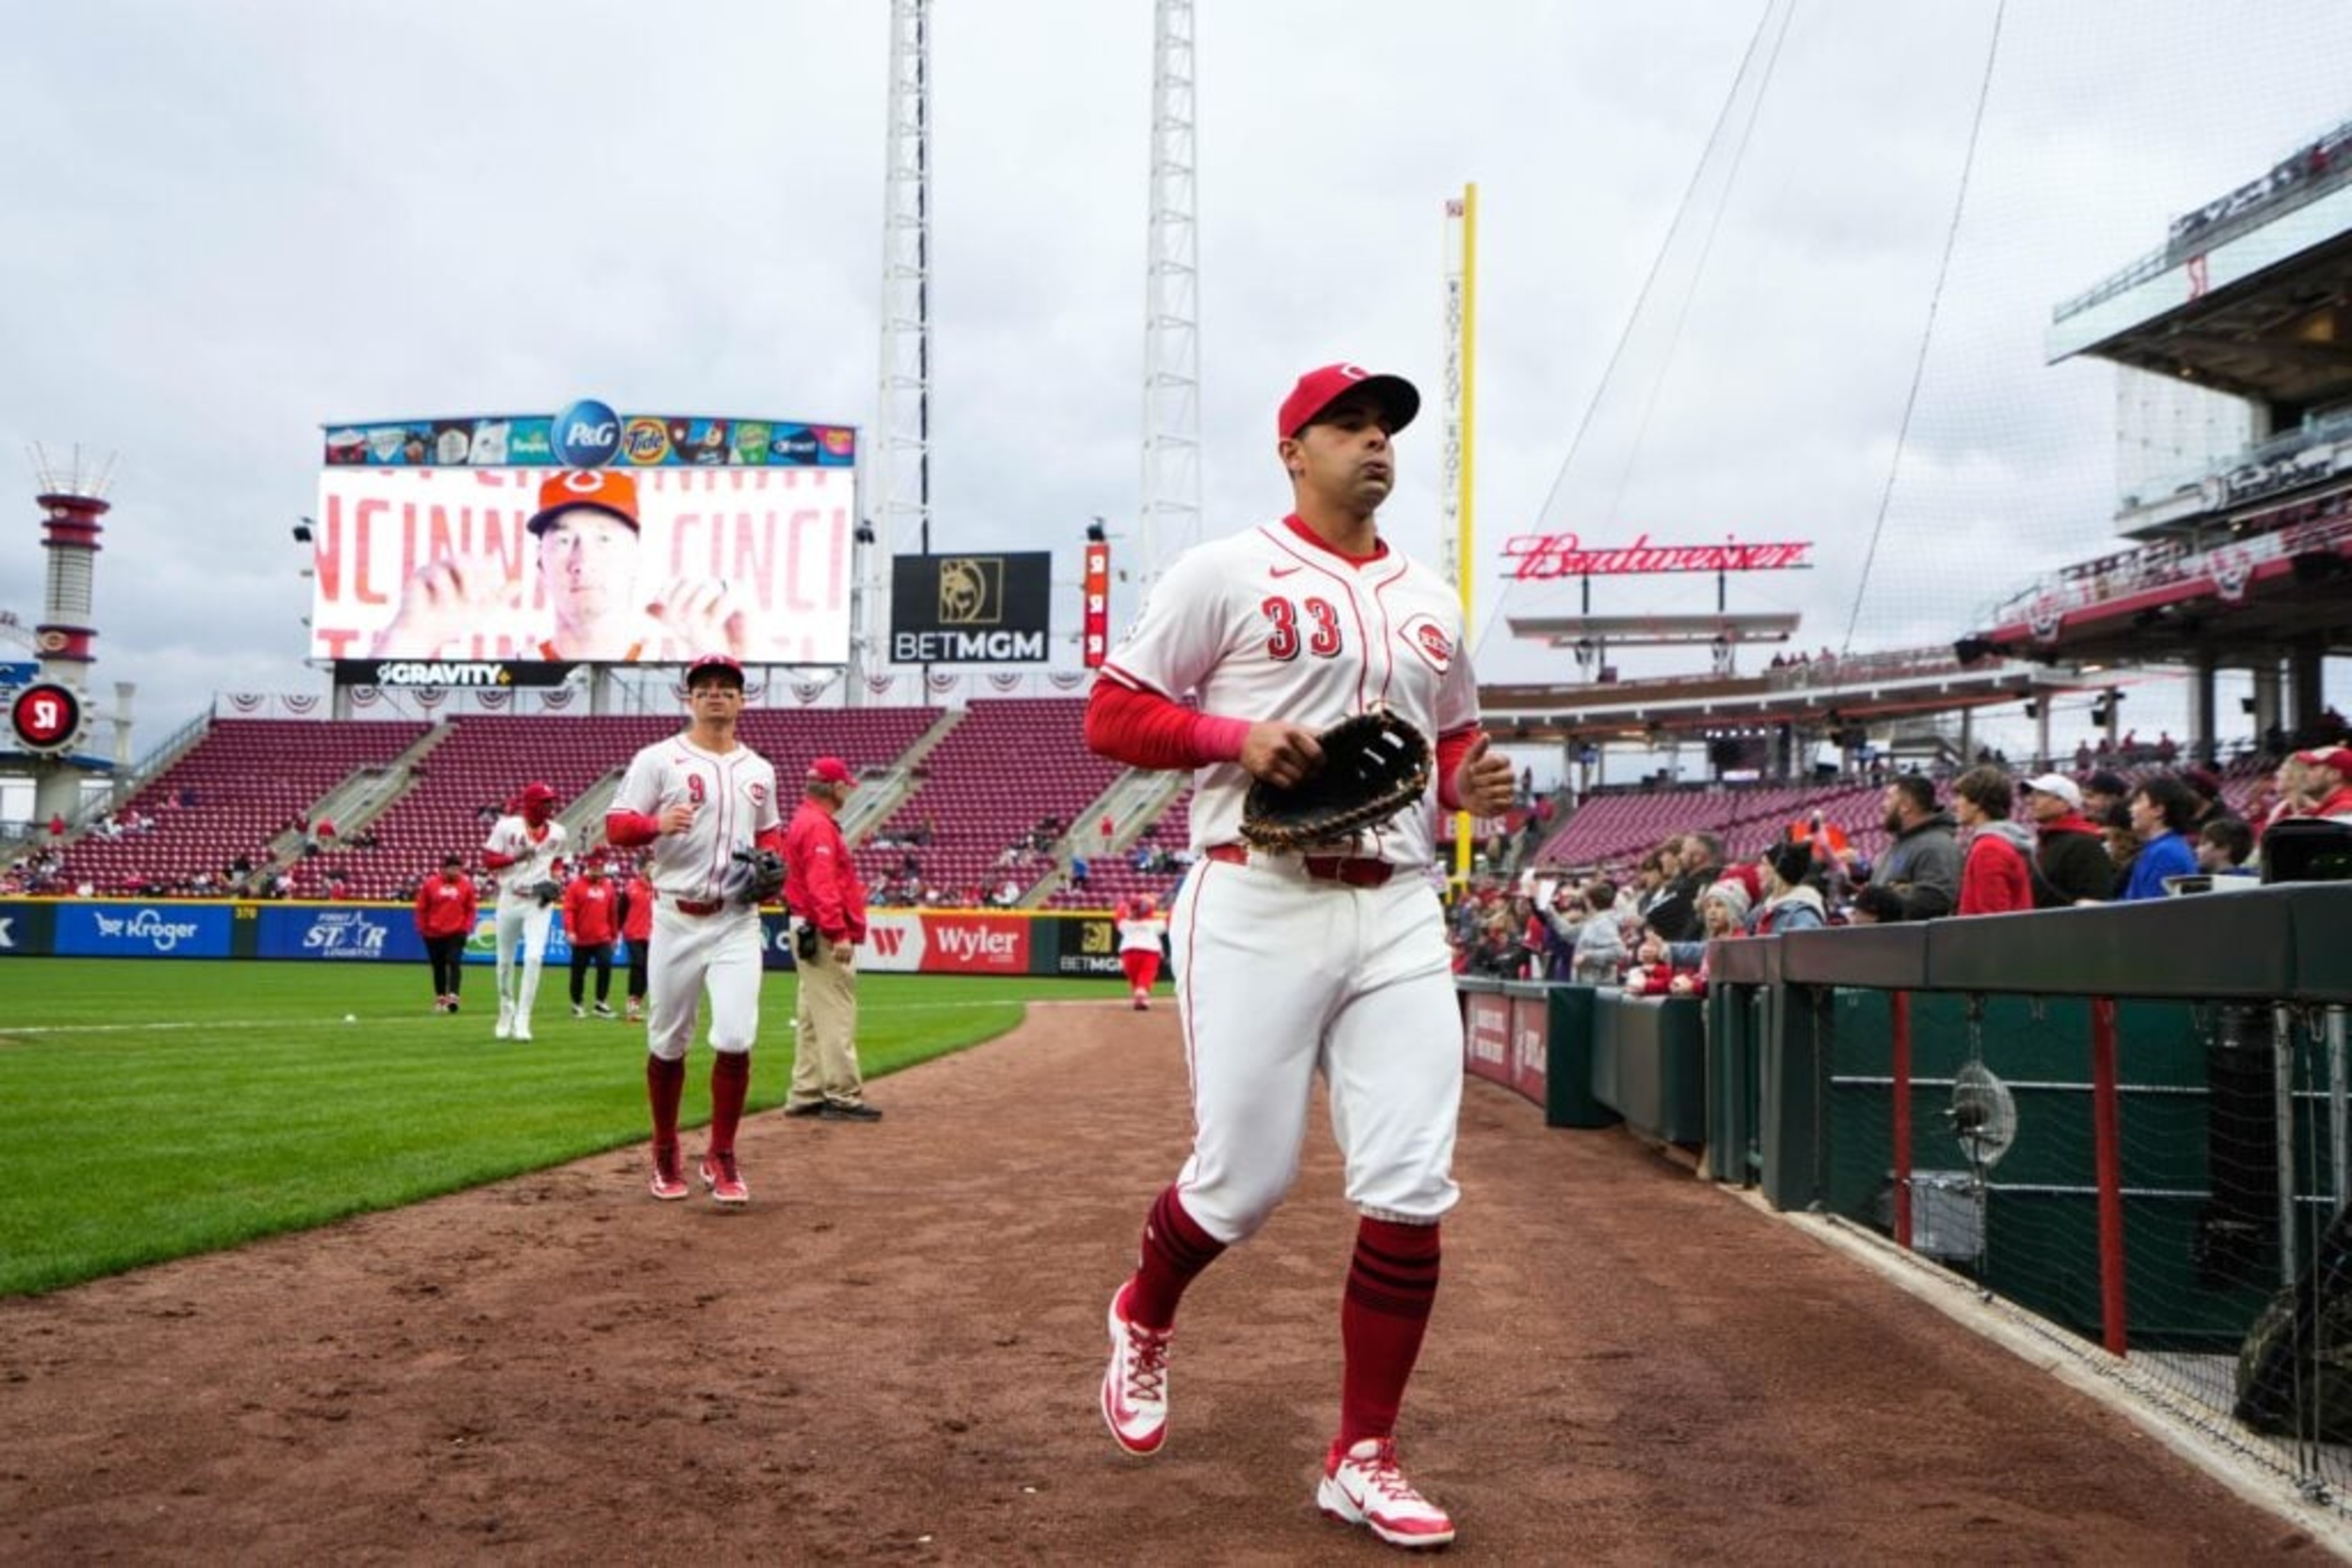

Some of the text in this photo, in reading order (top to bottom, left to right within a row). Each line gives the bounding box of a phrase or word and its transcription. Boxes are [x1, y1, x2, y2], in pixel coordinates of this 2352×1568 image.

[566, 422, 617, 447] P&G
[625, 428, 664, 454] Tide
[1506, 533, 1808, 580] Budweiser
[1262, 595, 1342, 661] 33
[895, 630, 1044, 660] BETMGM
[391, 662, 503, 685] GRAVITY
[688, 773, 705, 801] 9
[126, 909, 198, 951] Kroger
[936, 926, 1020, 963] Wyler
[1060, 955, 1123, 972] BETMG
